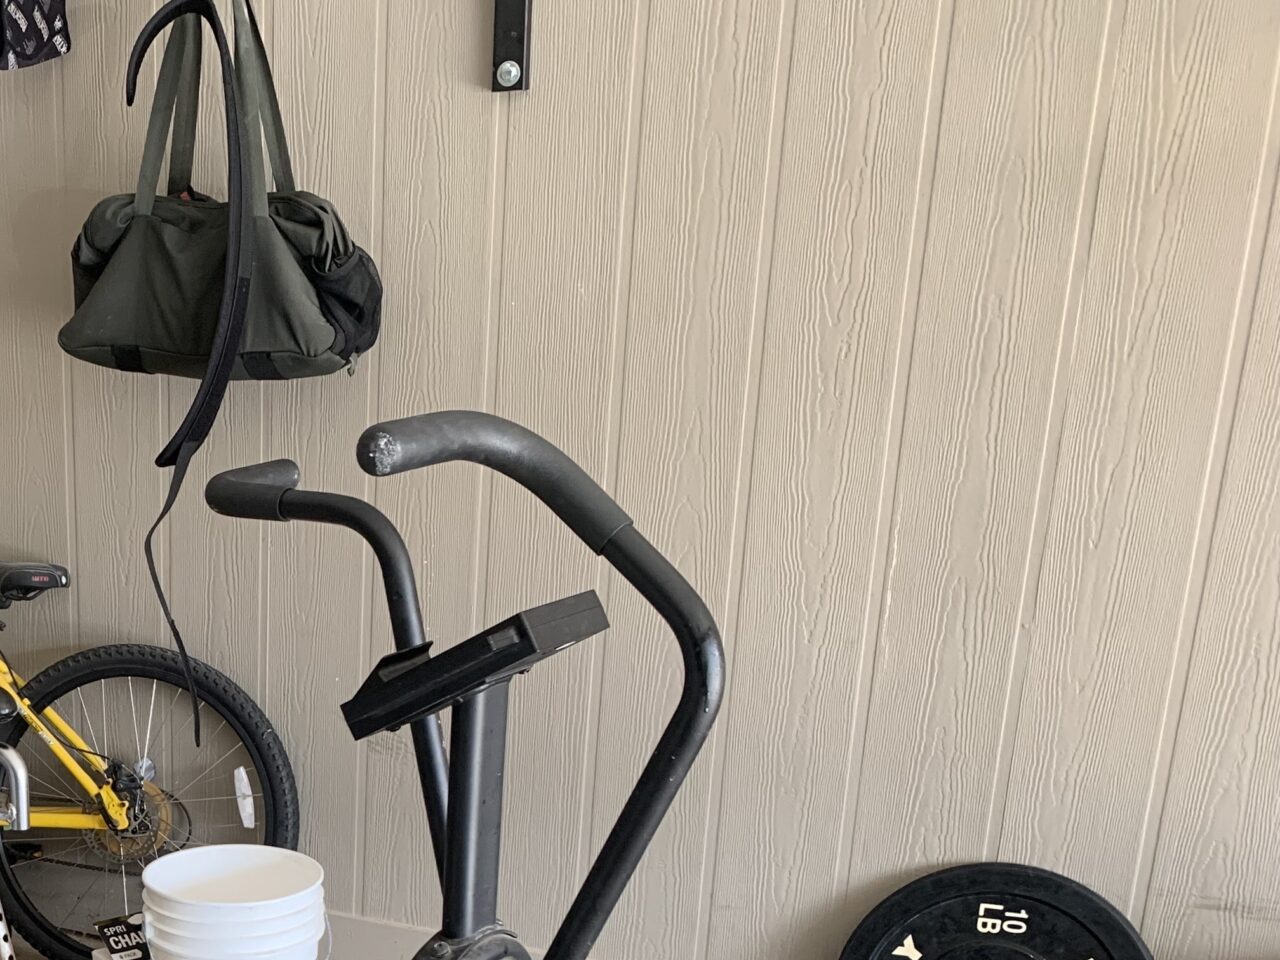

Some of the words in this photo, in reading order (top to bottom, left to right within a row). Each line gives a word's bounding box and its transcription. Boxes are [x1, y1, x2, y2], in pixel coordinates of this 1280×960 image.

[103, 924, 127, 936] SPRI
[976, 902, 1004, 934] LB
[1002, 909, 1029, 935] 10
